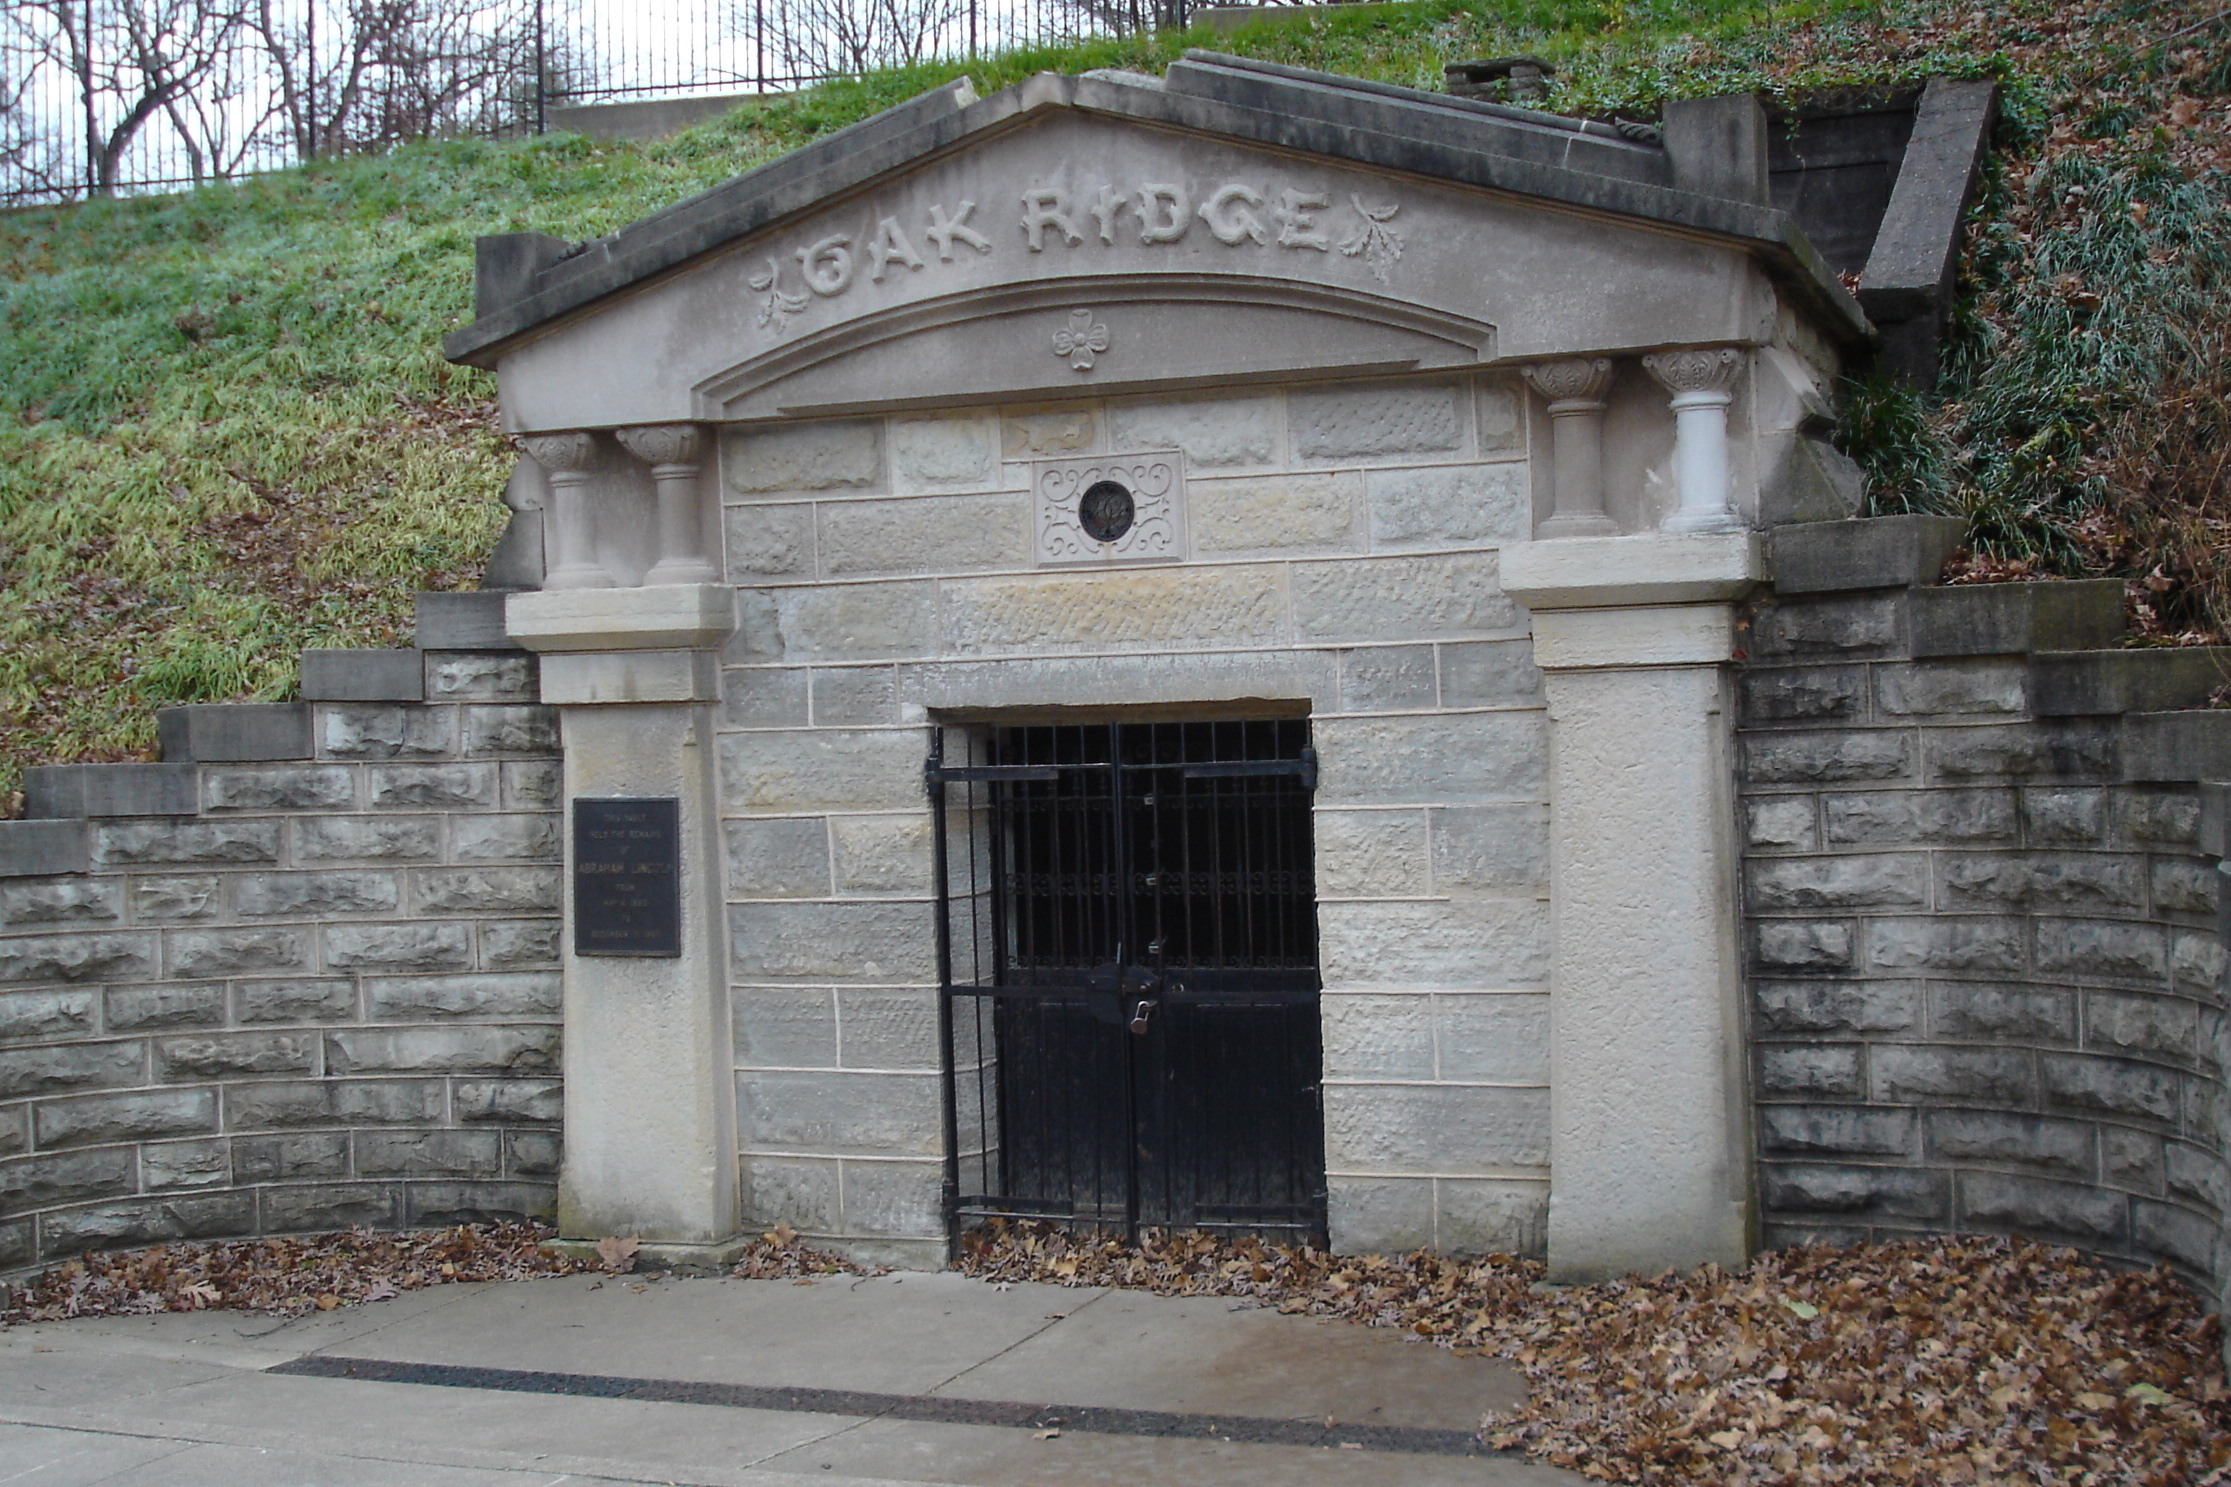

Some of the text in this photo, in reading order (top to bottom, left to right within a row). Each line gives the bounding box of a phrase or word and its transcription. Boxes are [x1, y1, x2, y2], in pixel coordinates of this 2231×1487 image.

[797, 183, 1329, 296] OAK RIDGE
[578, 862, 625, 874] ABRAHAM
